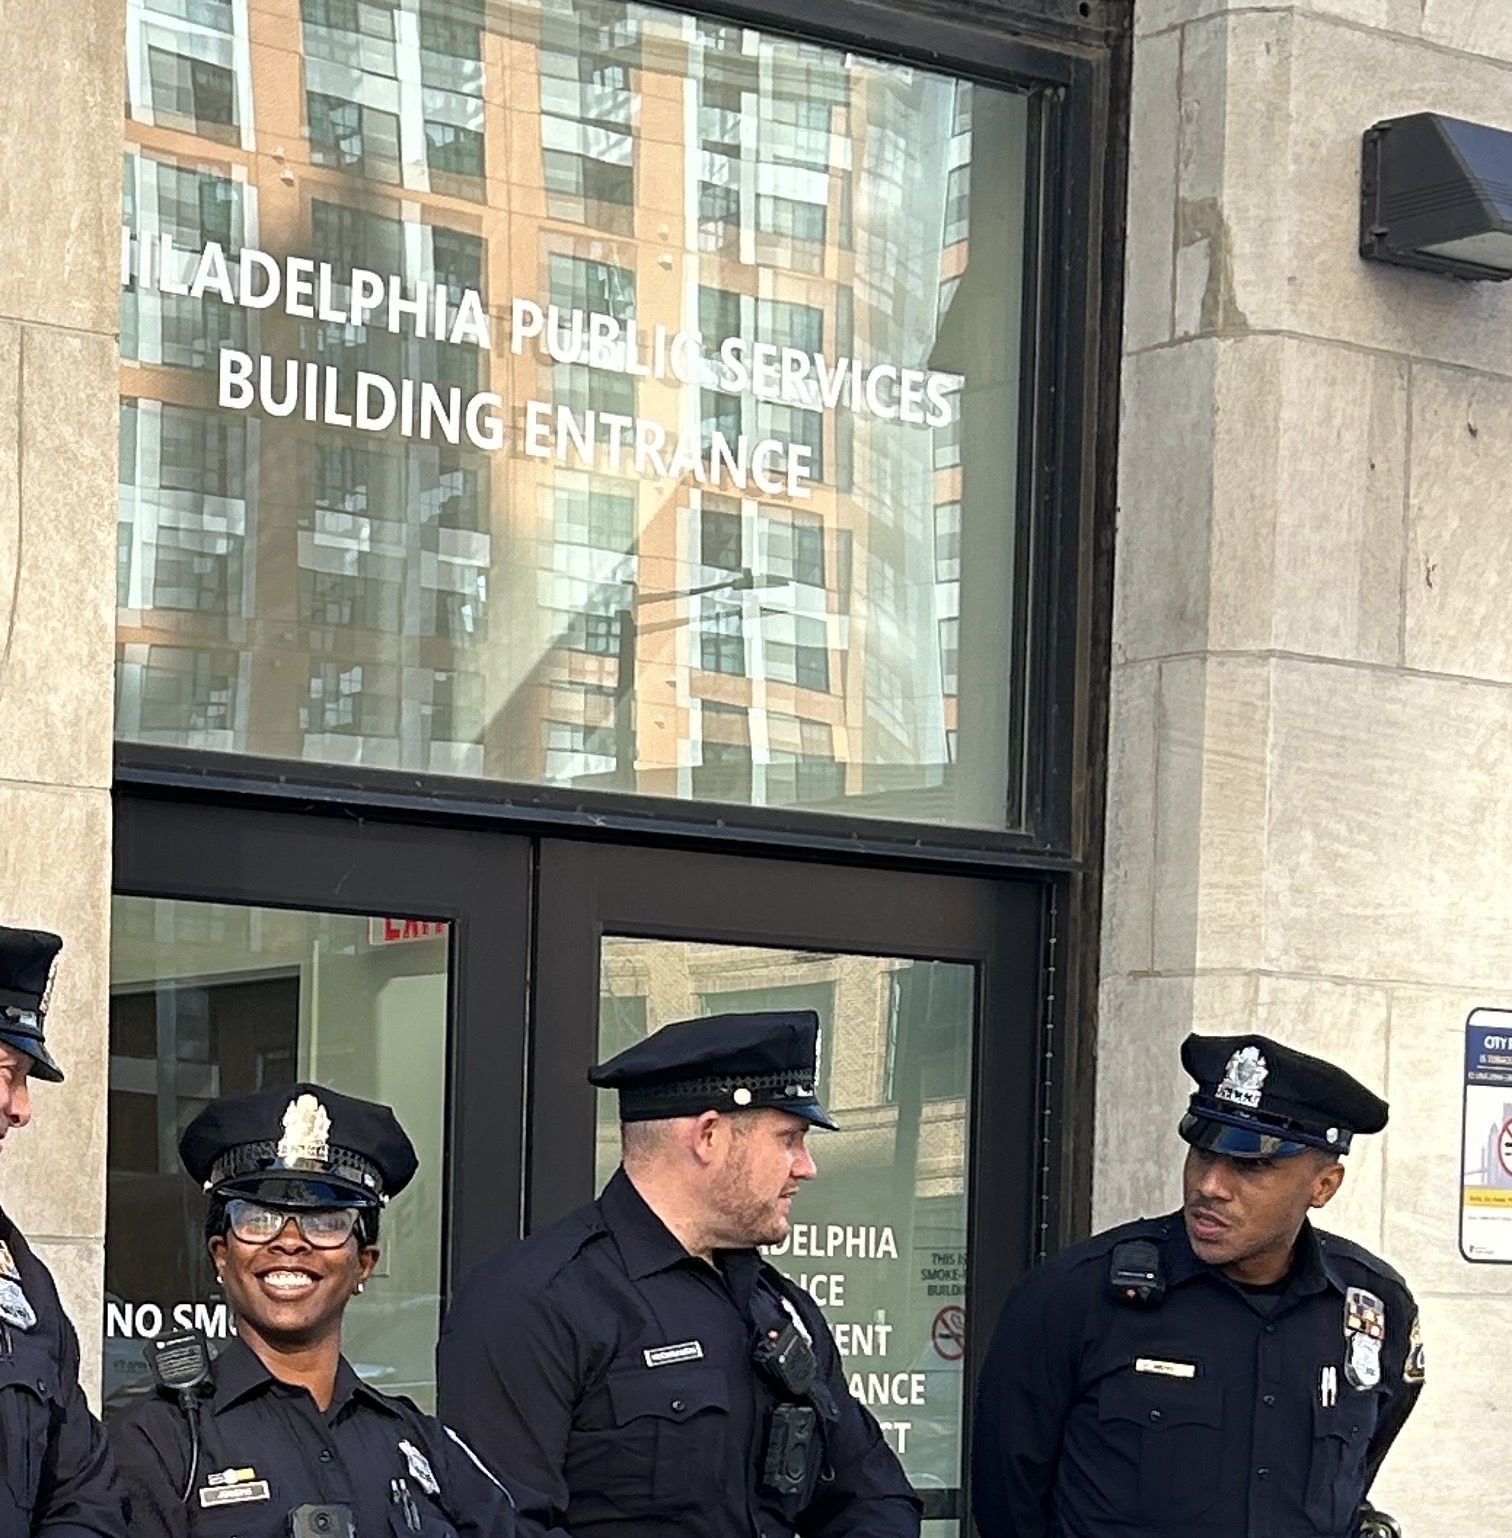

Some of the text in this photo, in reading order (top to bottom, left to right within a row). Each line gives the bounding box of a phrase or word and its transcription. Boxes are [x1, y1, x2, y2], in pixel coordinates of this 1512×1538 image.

[511, 297, 703, 384] PUBLIC
[719, 337, 953, 428] SERVICES
[219, 347, 812, 498] BUILDING ENTRANCE
[106, 1303, 163, 1338] NO
[827, 1325, 893, 1355] ENT
